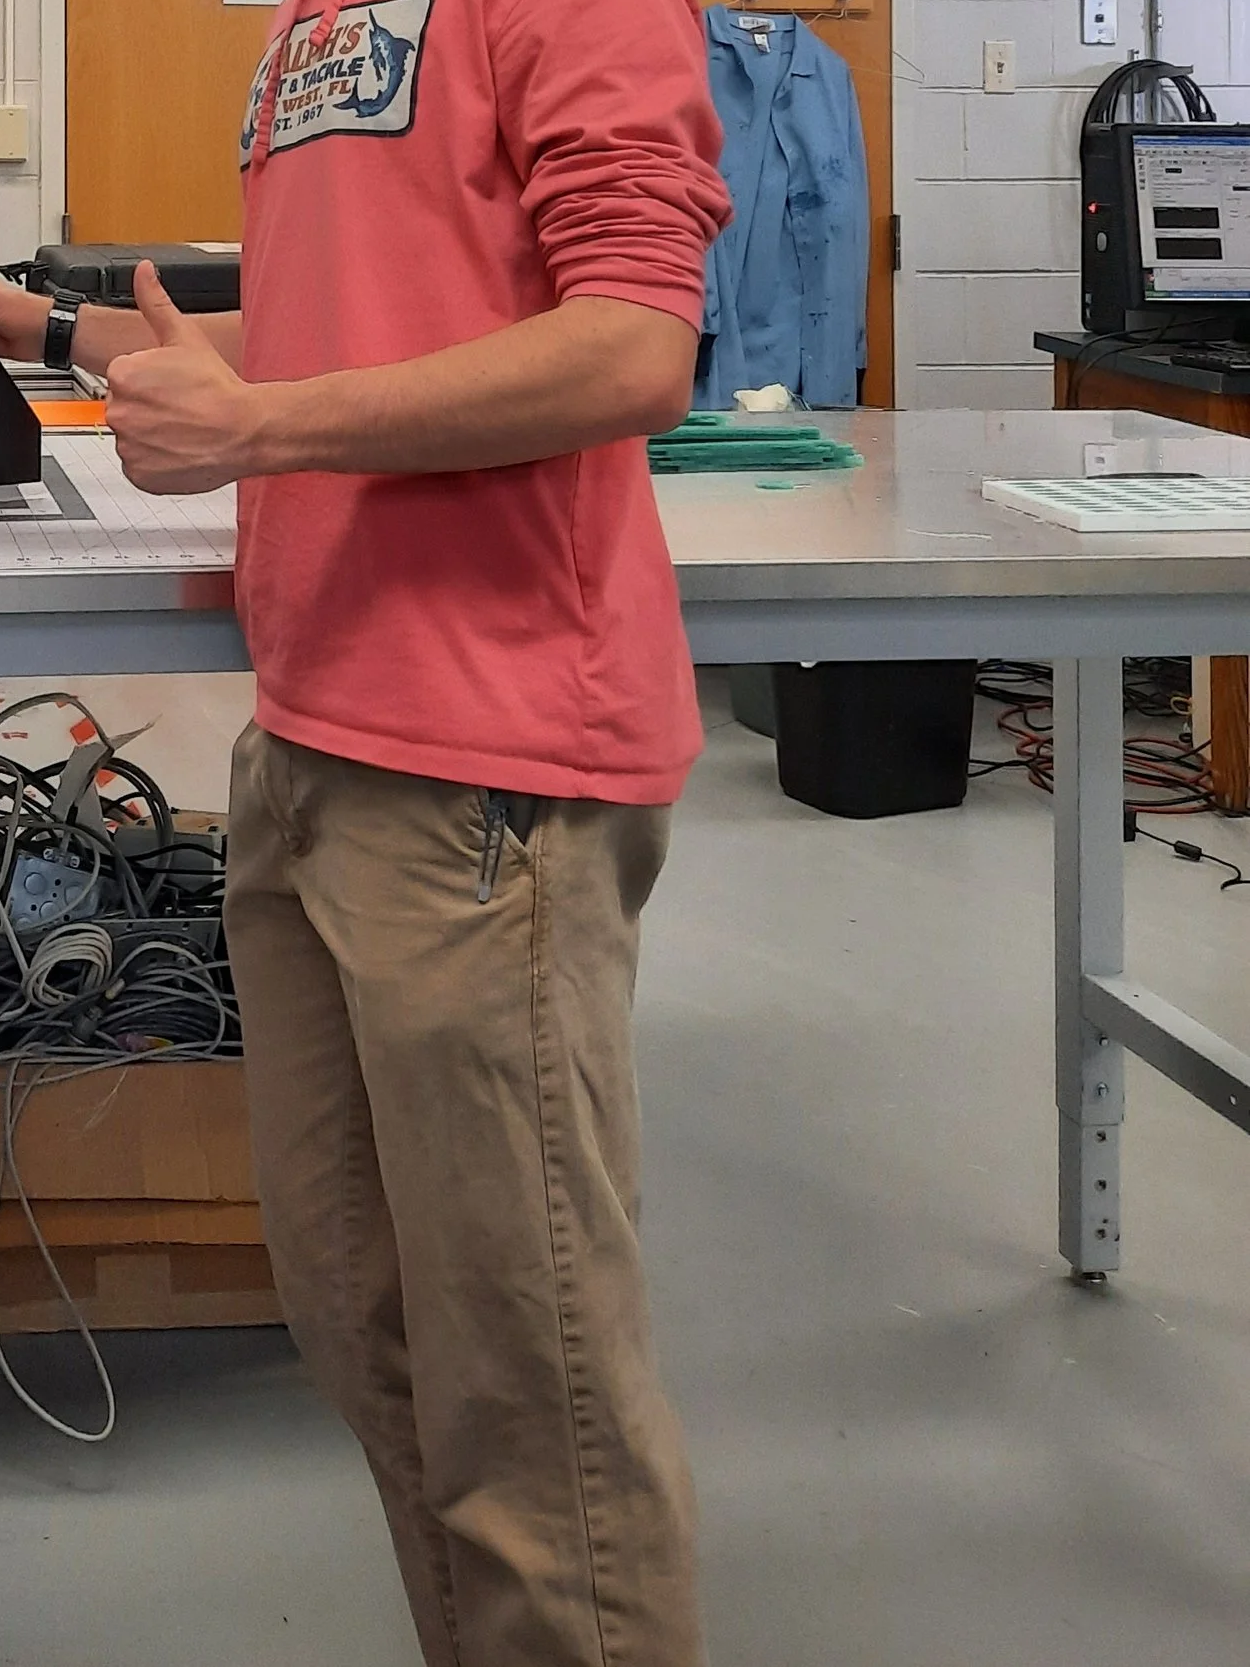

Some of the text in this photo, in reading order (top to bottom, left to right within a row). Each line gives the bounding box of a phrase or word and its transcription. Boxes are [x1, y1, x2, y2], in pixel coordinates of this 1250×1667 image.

[264, 21, 368, 80] ALPH'S
[302, 56, 366, 91] TACKLE
[327, 79, 352, 97] FL
[274, 117, 293, 132] ST.
